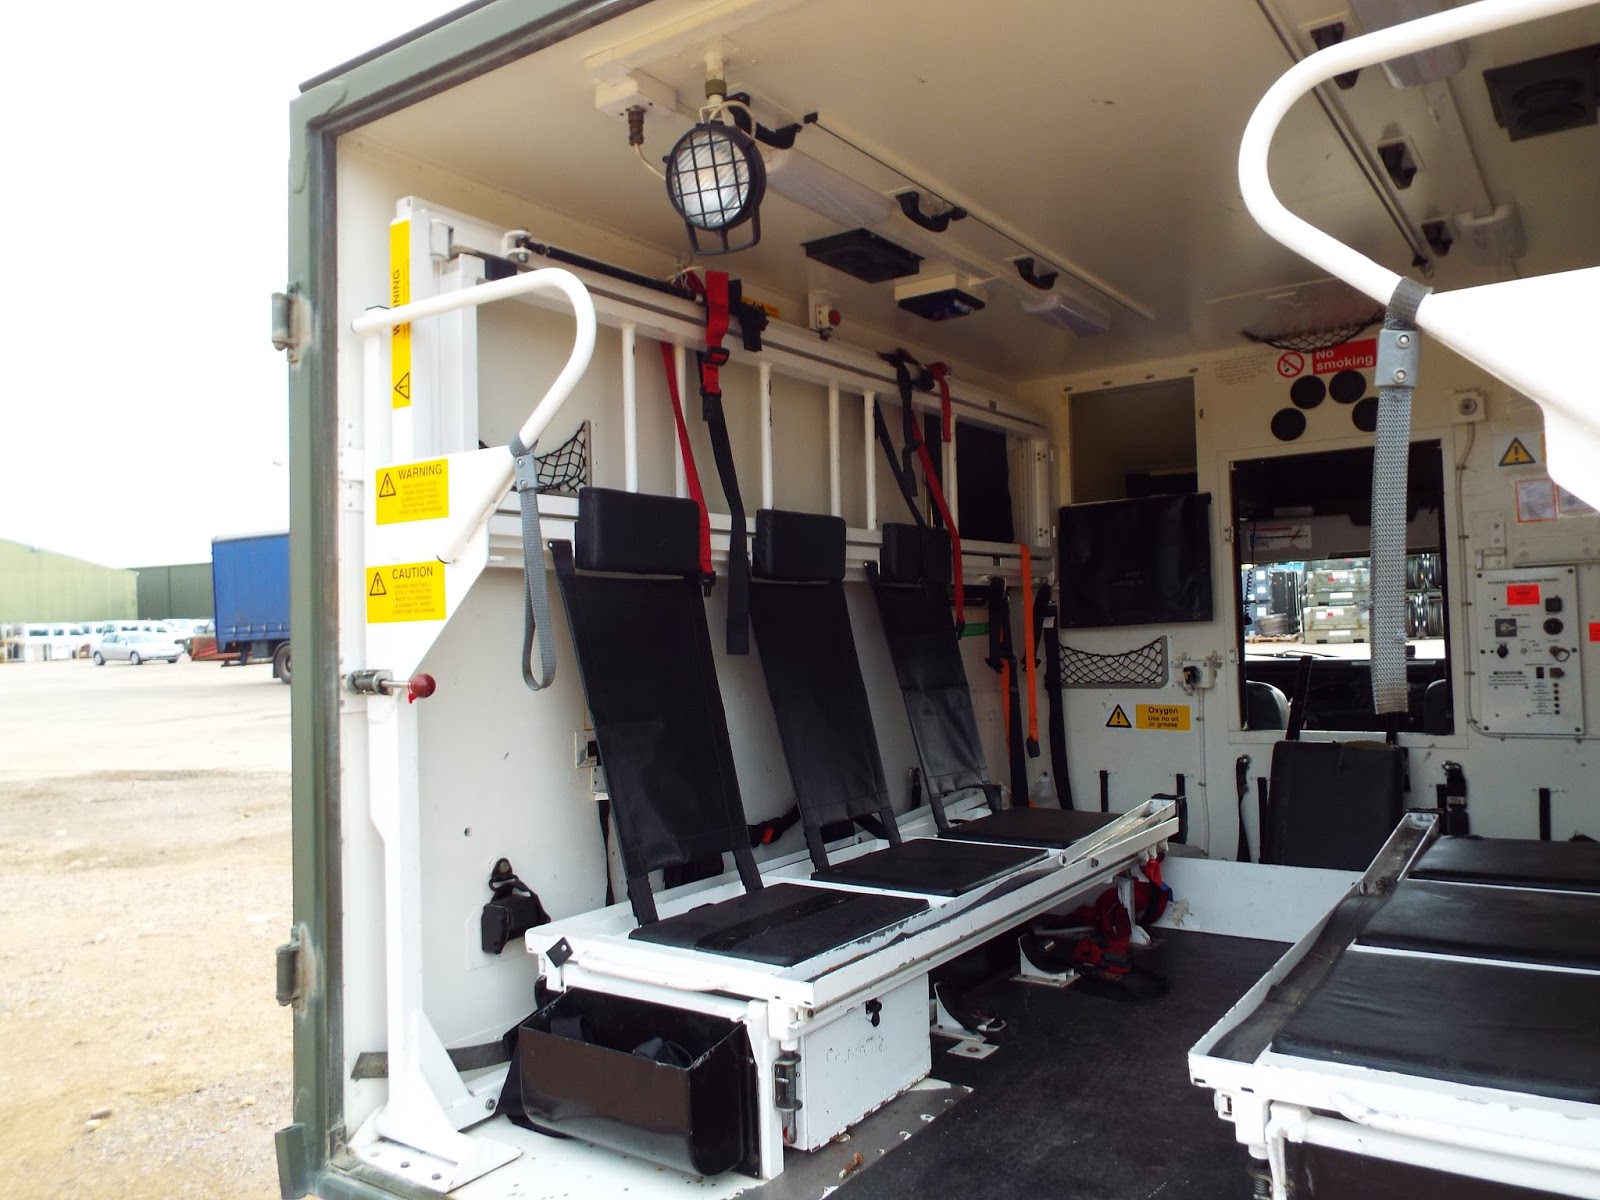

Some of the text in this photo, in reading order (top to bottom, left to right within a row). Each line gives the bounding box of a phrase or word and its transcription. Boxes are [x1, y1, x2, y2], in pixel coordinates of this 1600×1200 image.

[392, 269, 400, 336] WNING
[1316, 350, 1334, 359] No
[1316, 355, 1374, 370] smoking
[398, 463, 442, 480] WARNING
[392, 565, 434, 580] CAUTION
[1148, 706, 1178, 715] Oxygen
